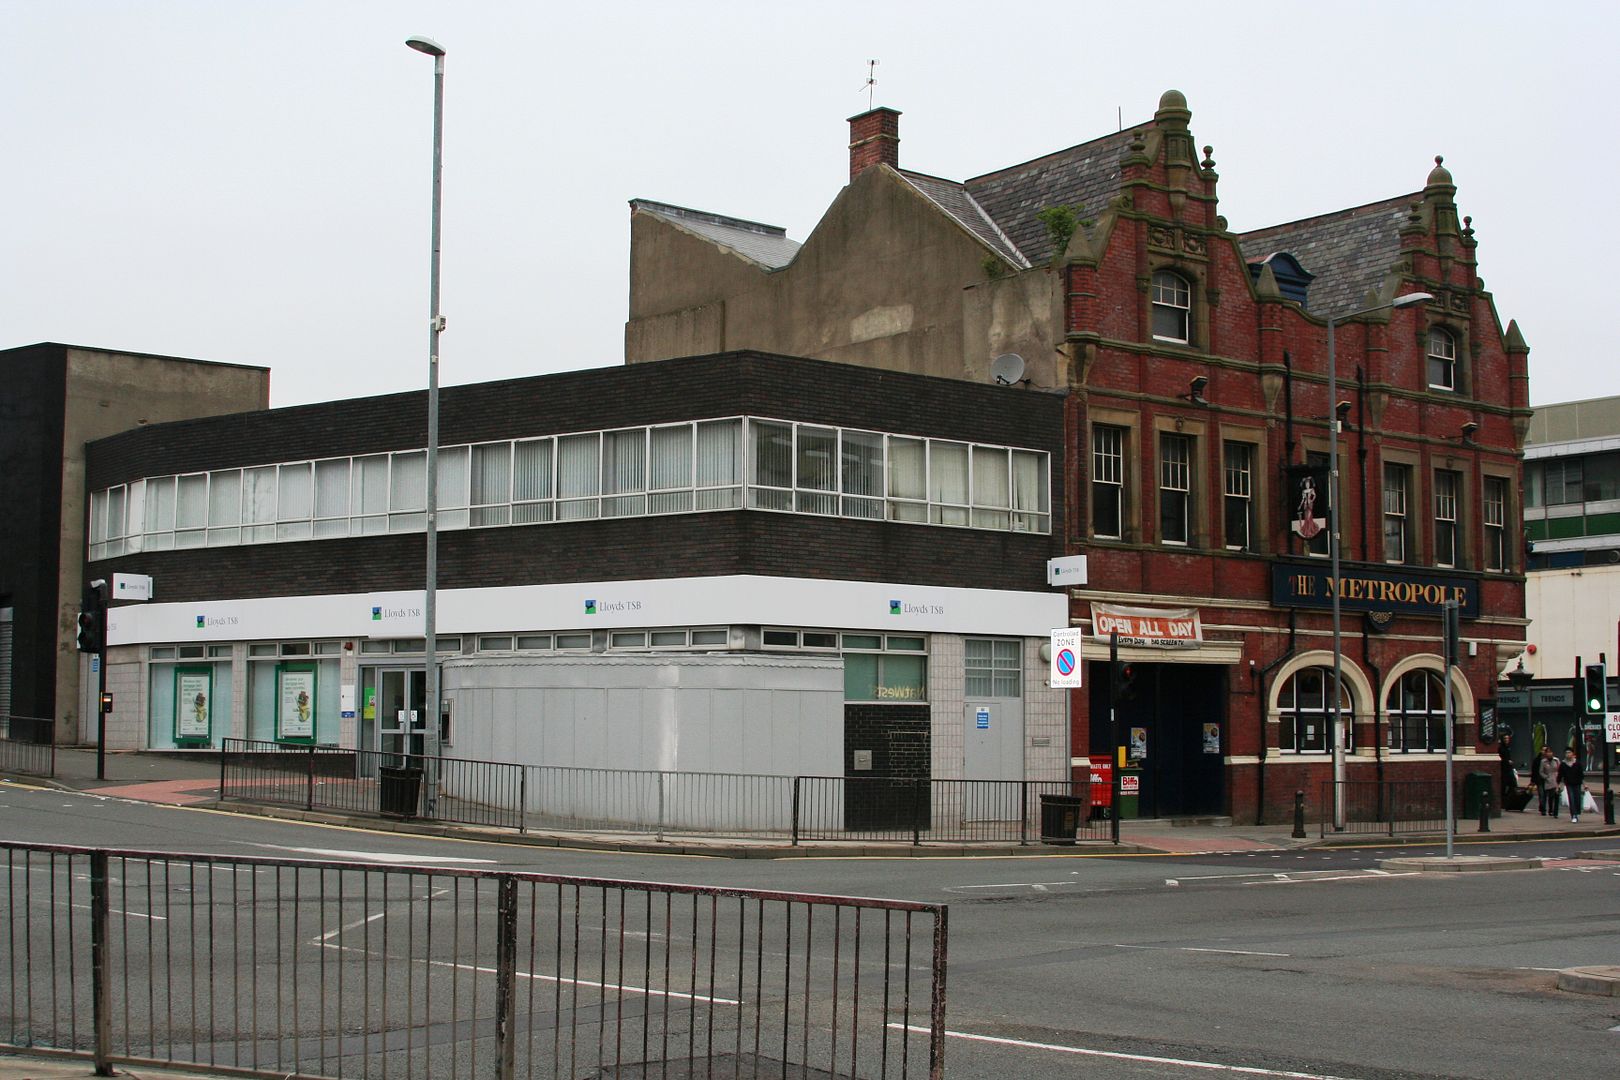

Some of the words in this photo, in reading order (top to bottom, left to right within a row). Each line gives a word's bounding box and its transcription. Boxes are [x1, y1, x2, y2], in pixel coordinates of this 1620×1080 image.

[1289, 575, 1315, 596] THE
[1325, 576, 1467, 607] METROPOLE
[599, 601, 625, 614] Lloyds
[626, 601, 642, 610] TSB
[904, 603, 928, 615] Lloyds
[930, 605, 944, 614] TSB
[384, 608, 406, 620] Lloyds
[407, 608, 421, 617] TSB
[207, 617, 226, 627] Lloyds
[227, 616, 239, 625] TSB
[1100, 616, 1133, 634] OPEN
[1139, 620, 1164, 636] ALL
[1168, 621, 1193, 637] DAY
[1056, 638, 1075, 647] ZONE
[1541, 695, 1566, 703] TRENDS
[1122, 776, 1138, 786] Biffa
